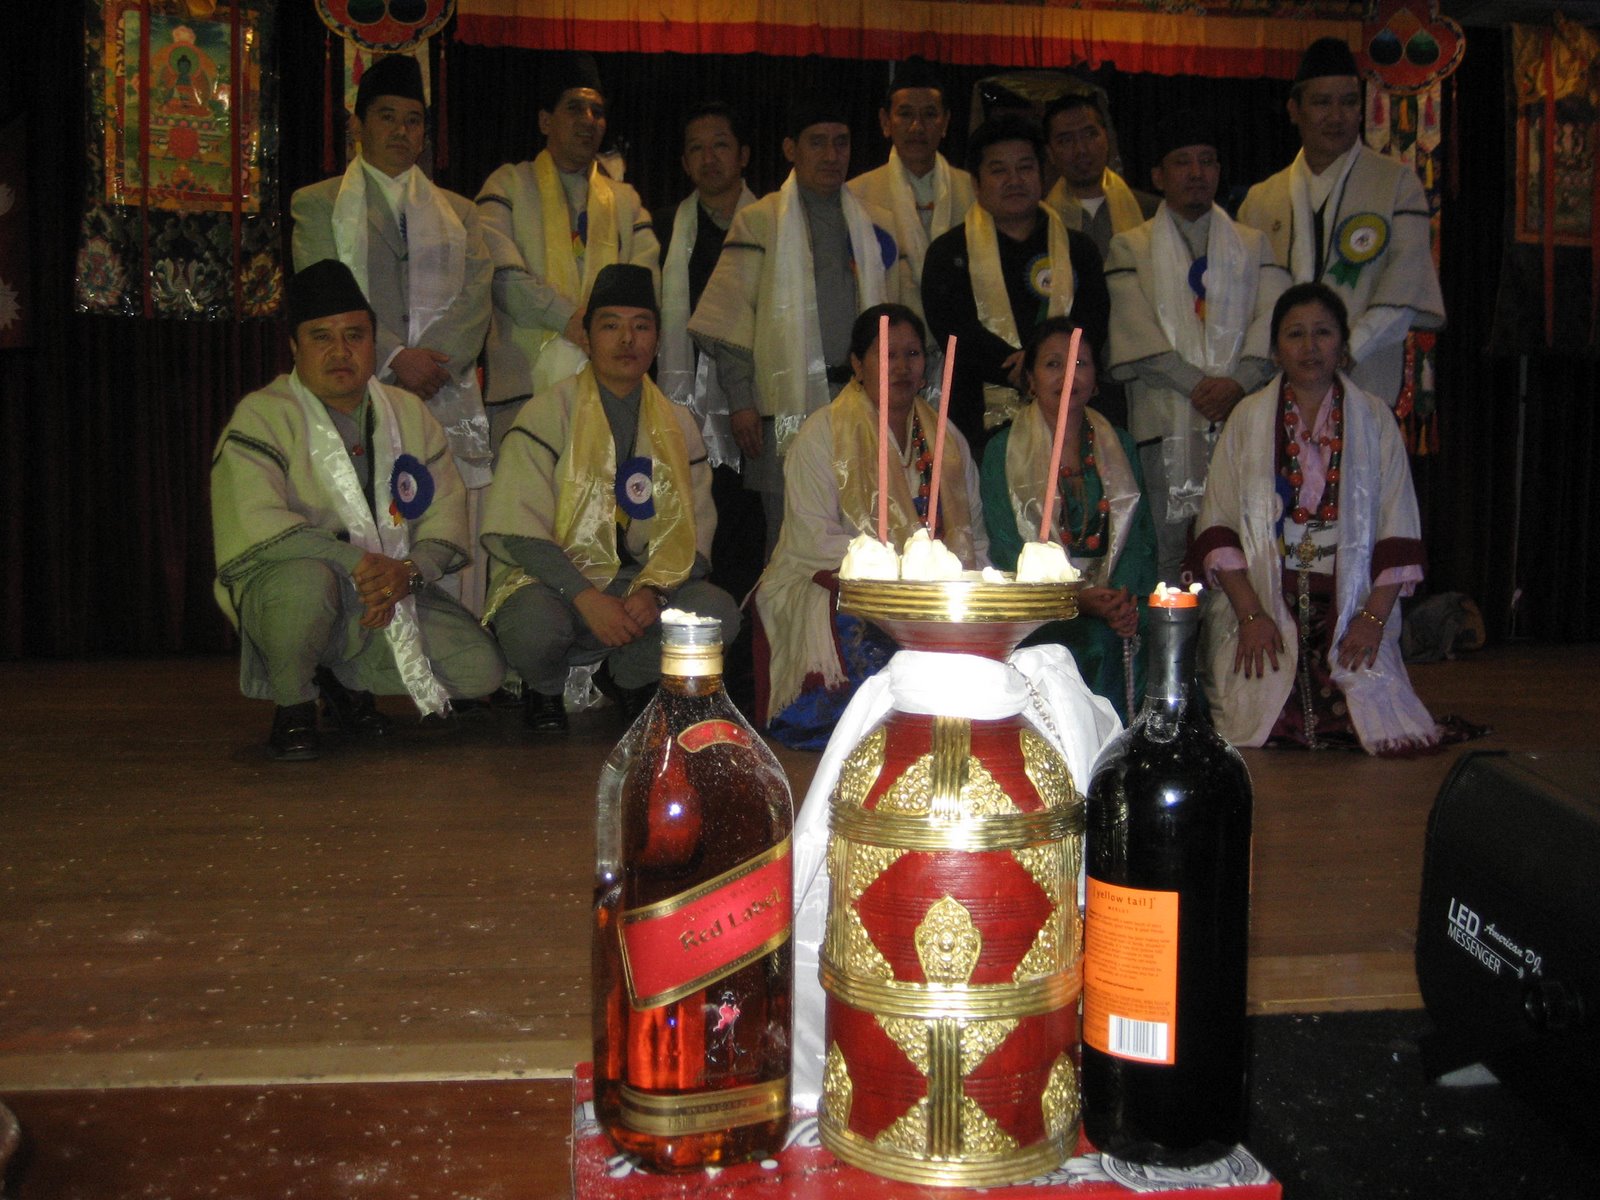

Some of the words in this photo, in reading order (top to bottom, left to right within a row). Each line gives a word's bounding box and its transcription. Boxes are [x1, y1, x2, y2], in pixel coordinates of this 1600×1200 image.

[680, 919, 723, 952] Red
[727, 888, 782, 928] Label
[1448, 897, 1480, 938] LED
[1484, 923, 1523, 957] American
[1447, 922, 1501, 975] MESSENGER
